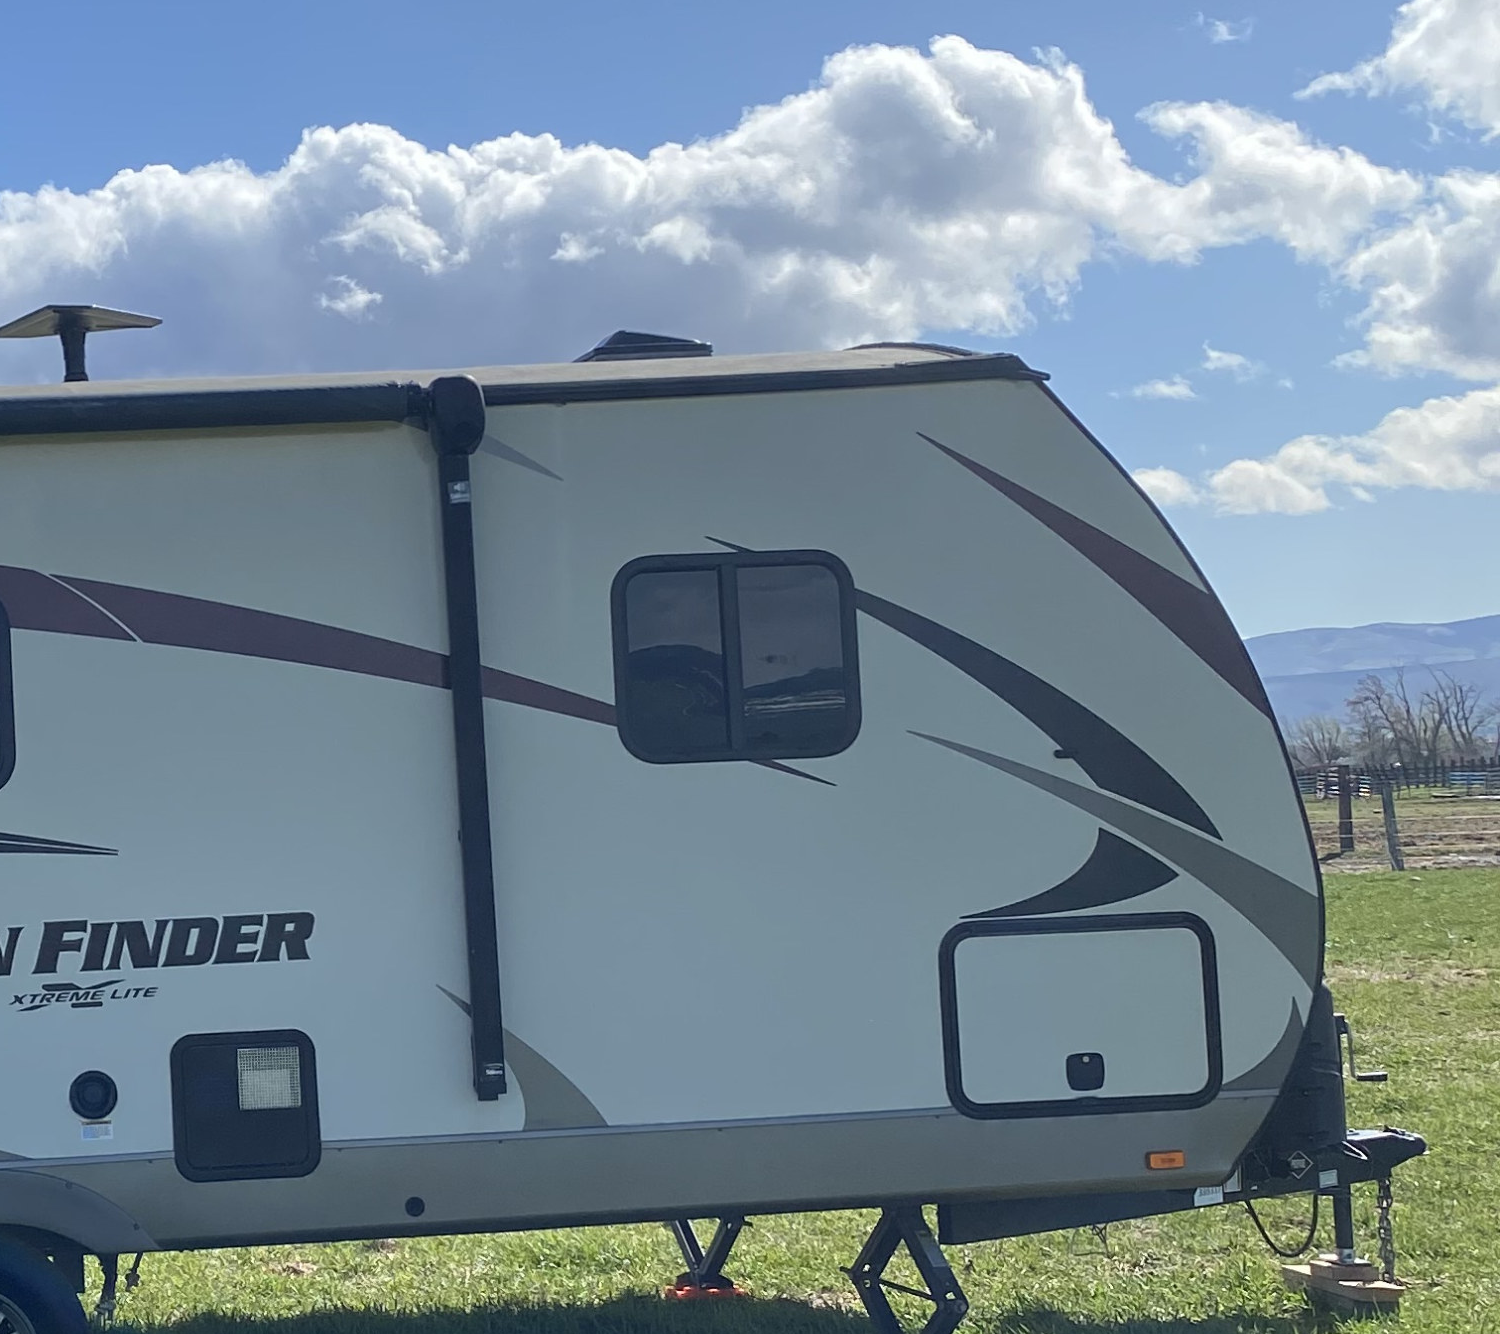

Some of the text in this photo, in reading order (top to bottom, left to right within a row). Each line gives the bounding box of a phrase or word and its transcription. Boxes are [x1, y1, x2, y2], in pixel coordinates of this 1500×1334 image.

[31, 911, 316, 975] FINDER
[8, 986, 160, 1006] XTREME LITE
